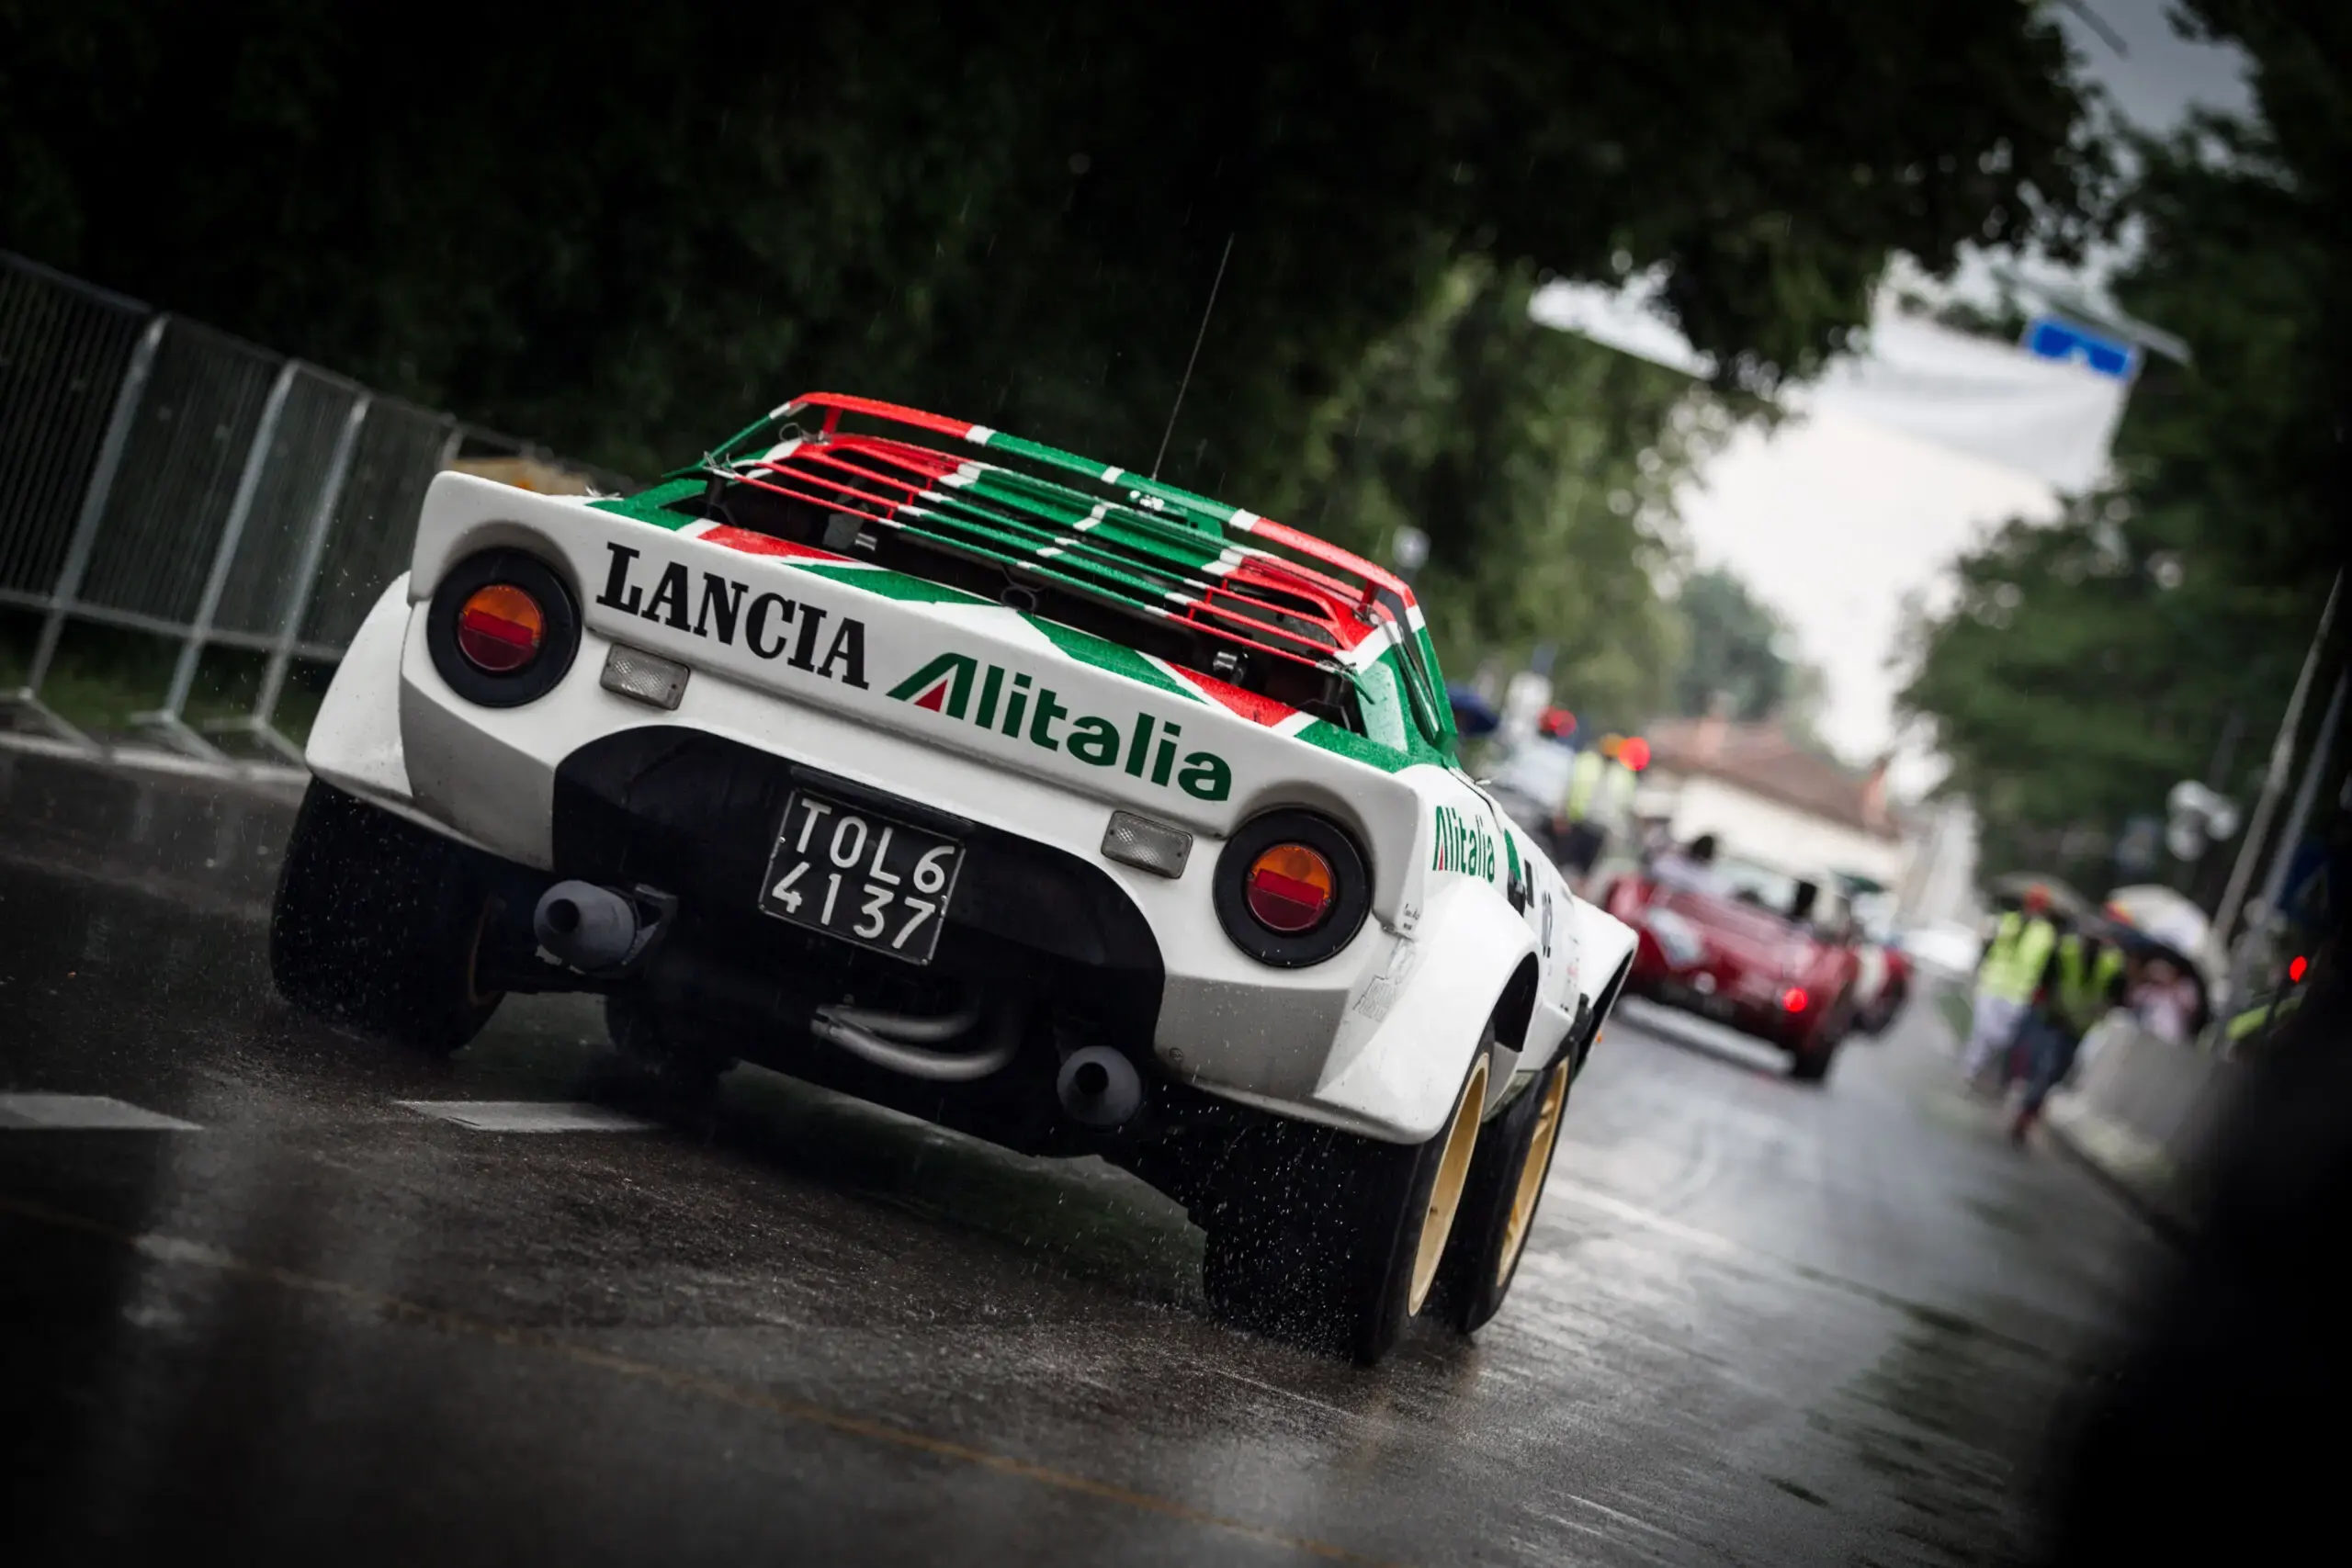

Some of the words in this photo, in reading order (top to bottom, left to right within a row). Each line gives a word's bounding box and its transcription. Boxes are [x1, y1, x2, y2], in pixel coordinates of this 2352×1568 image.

[595, 541, 869, 691] LANCIA
[885, 651, 1232, 802] Alitalia
[1432, 806, 1495, 884] Alitalia
[772, 862, 936, 950] 4137
